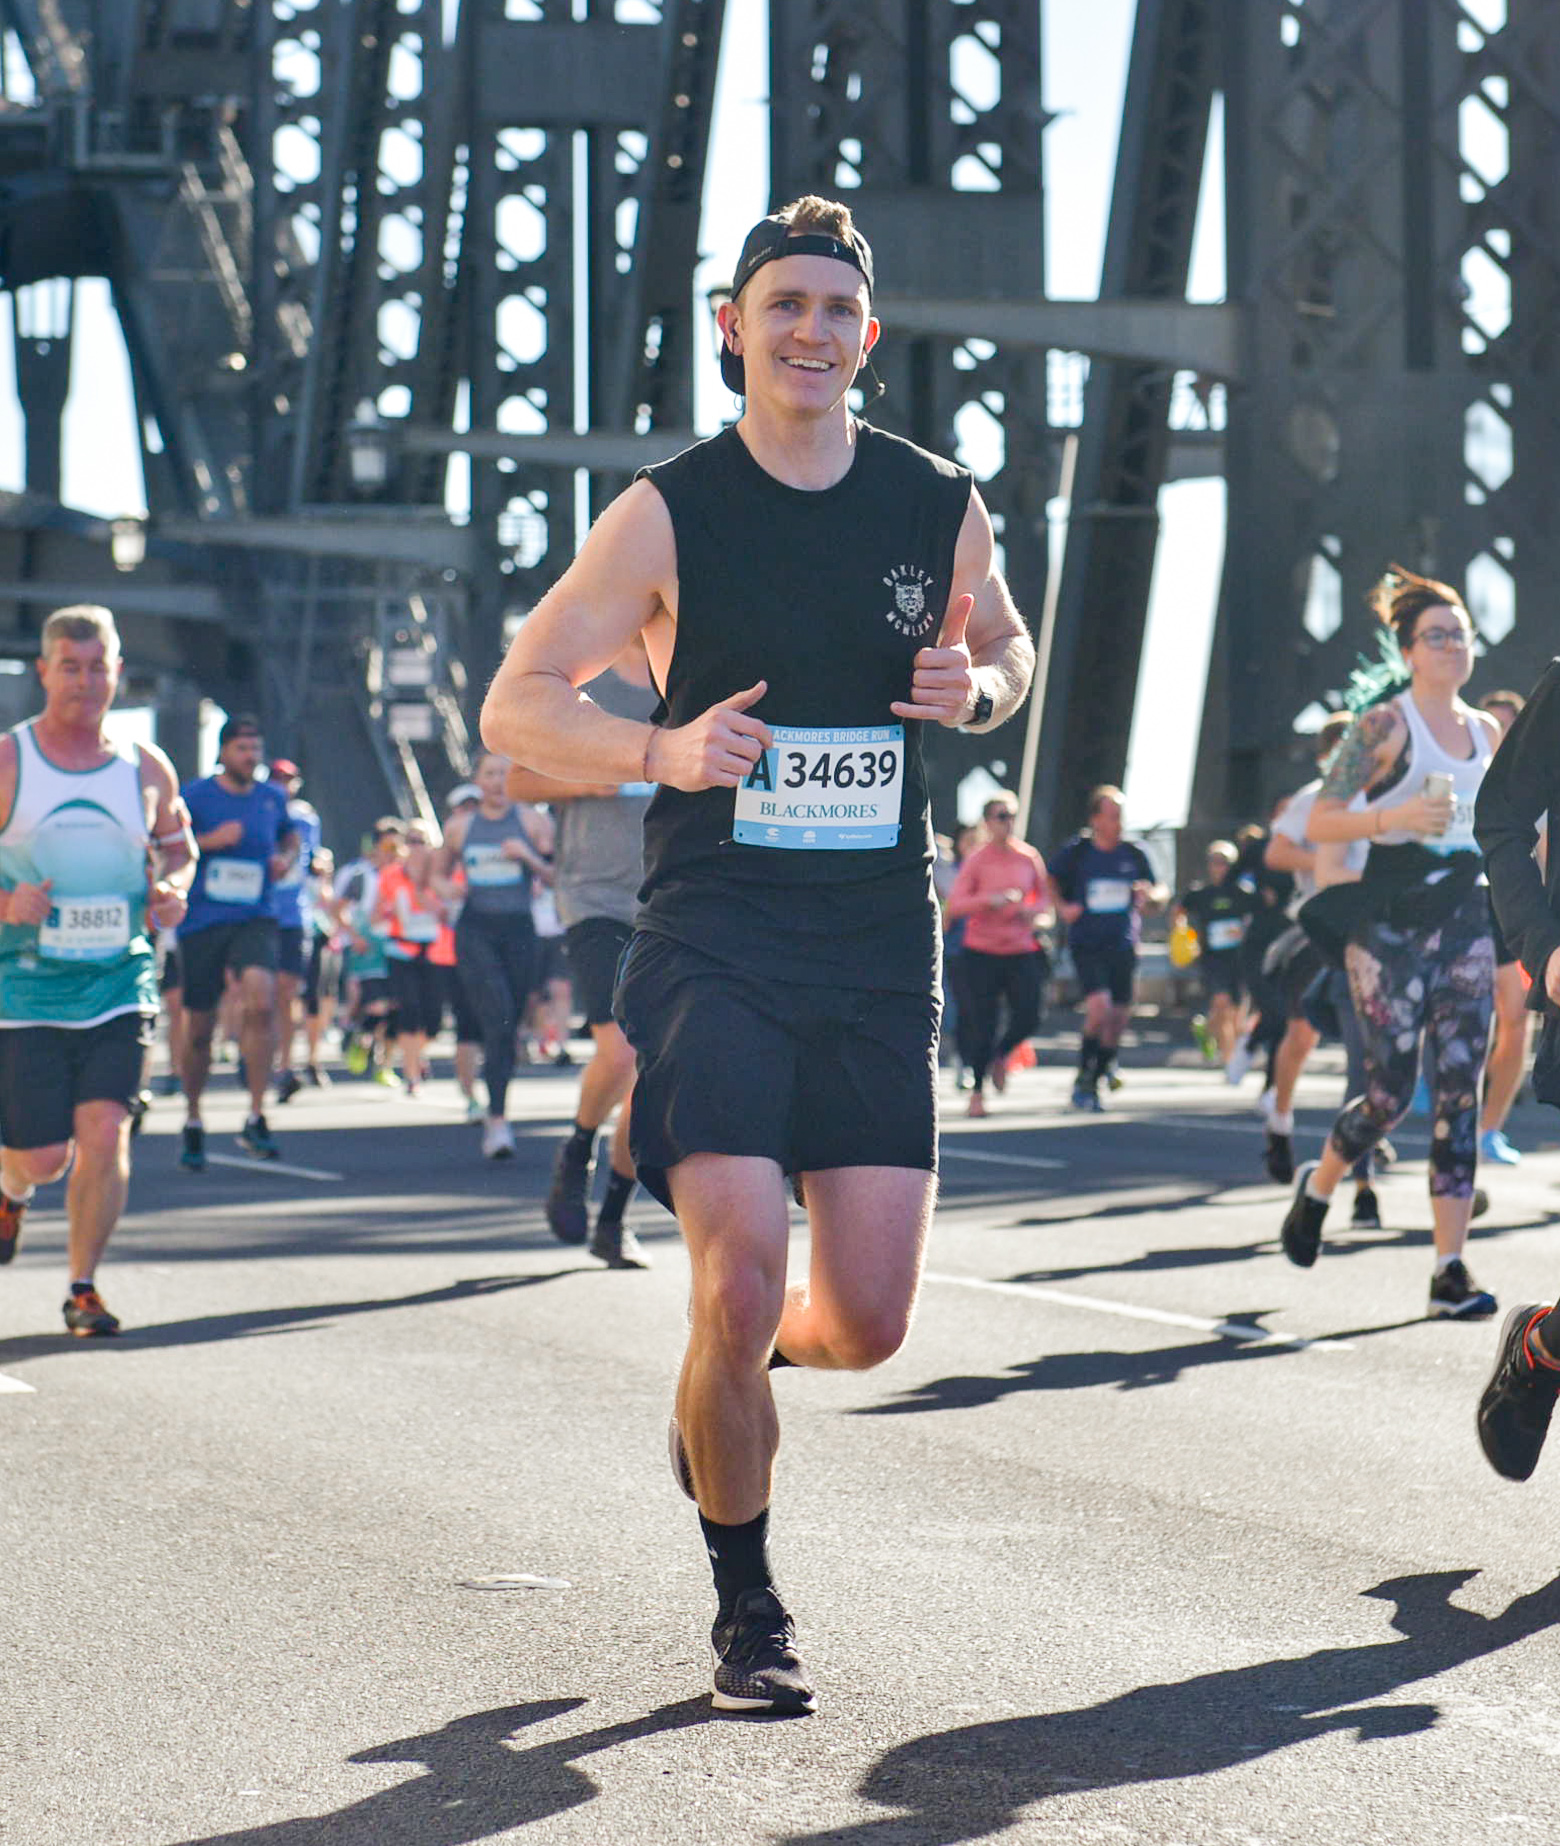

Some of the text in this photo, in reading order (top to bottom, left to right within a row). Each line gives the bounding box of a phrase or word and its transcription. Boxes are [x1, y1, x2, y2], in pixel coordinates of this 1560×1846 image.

[882, 565, 934, 587] OAKLEY
[773, 729, 890, 743] ACKMORES BRIDGE RUN
[747, 749, 897, 791] A 34639
[760, 801, 878, 819] BLACKMORES
[68, 907, 123, 930] 38812
